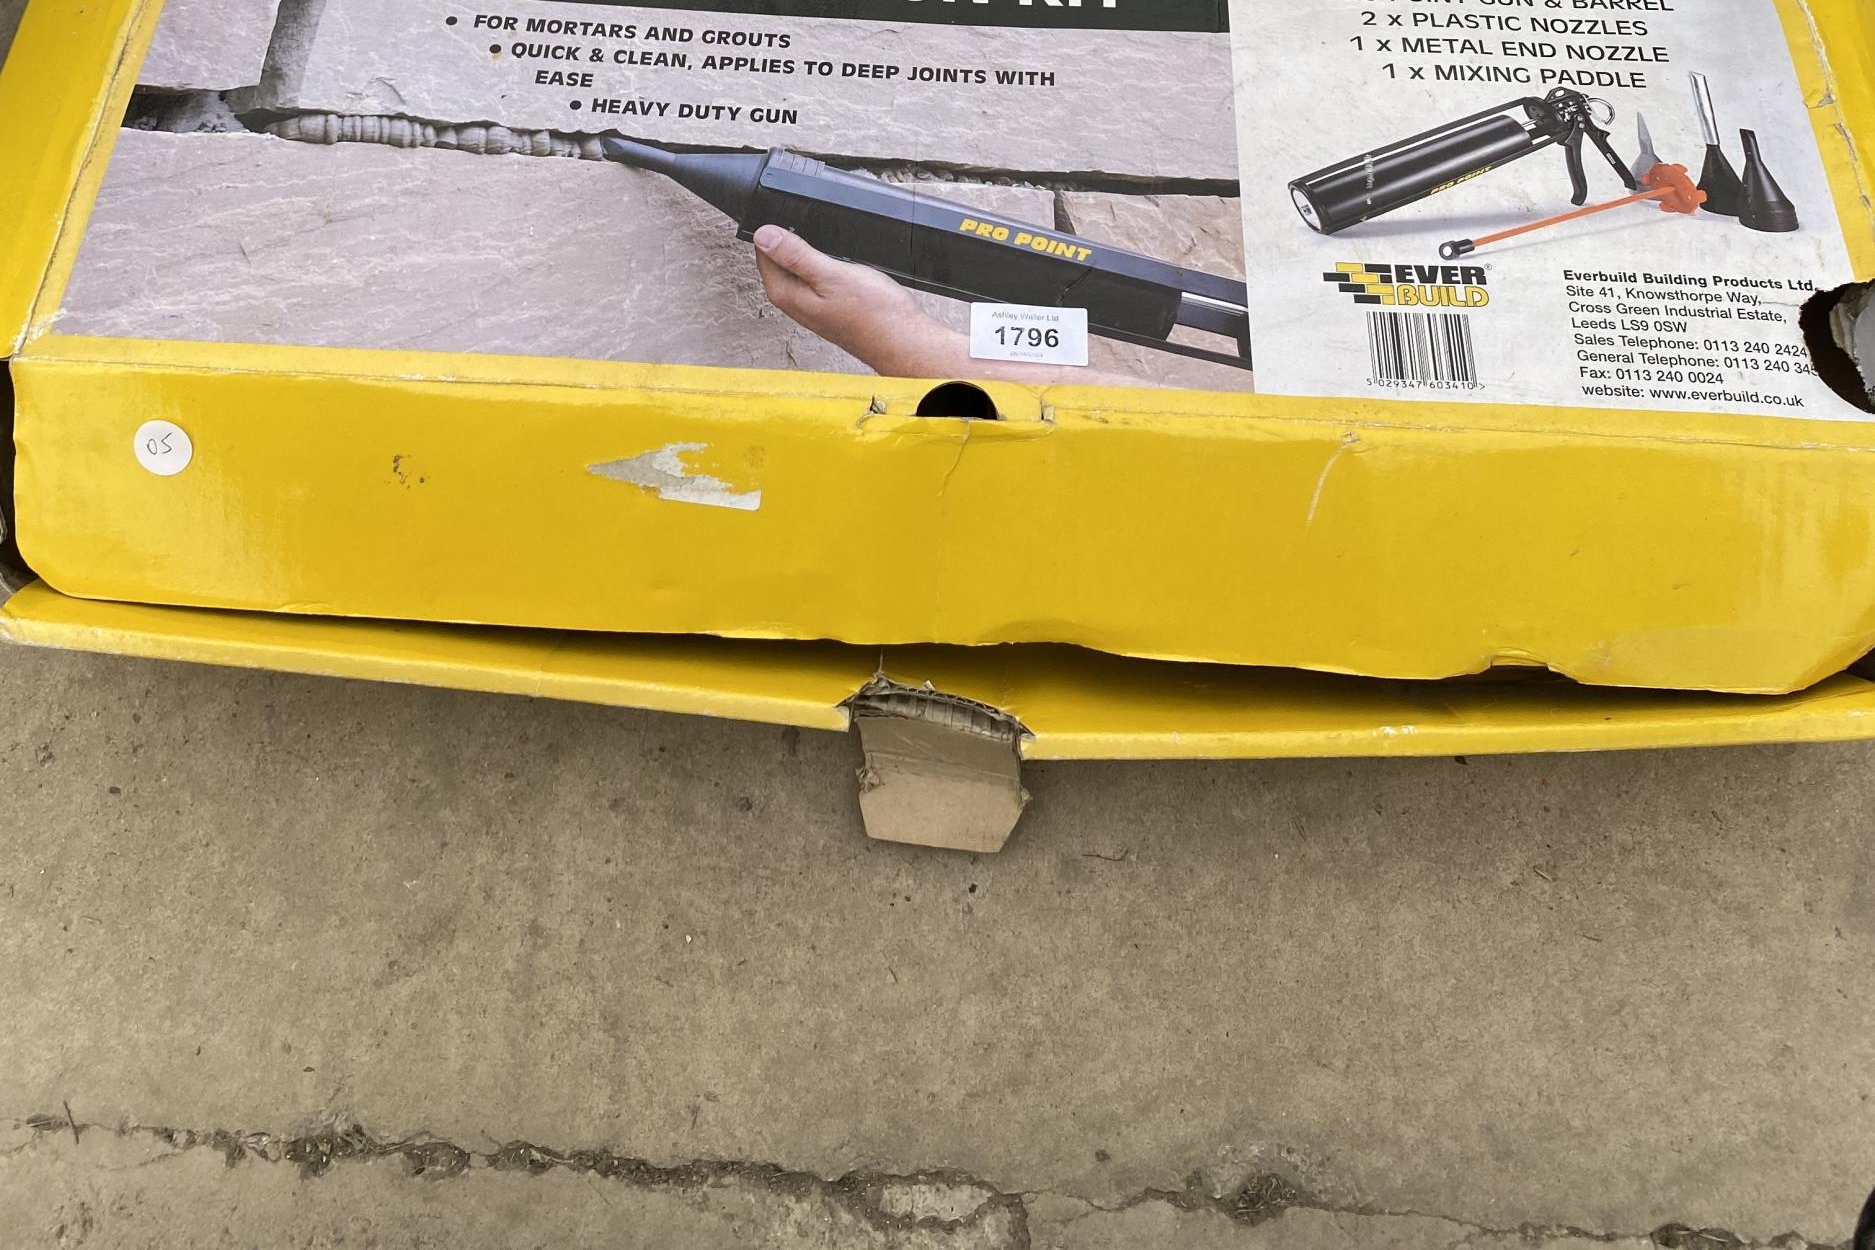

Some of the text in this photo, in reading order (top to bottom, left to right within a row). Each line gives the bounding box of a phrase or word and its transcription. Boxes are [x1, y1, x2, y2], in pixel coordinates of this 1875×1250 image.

[473, 14, 792, 49] FOR MORTARS AND GROUTS
[1362, 11, 1648, 36] 2 x PLASTIC NOZZLES
[1350, 35, 1670, 63] 1 x METAL END NOZZLE
[511, 42, 1056, 87] QUICK & CLEAN, APPLIES TO DEEP JOINTS WITH
[1382, 63, 1647, 88] 1 x MIXING PADDLE
[535, 70, 594, 88] EASE
[591, 97, 798, 125] HEAVY DUTY GUN
[959, 218, 1093, 261] PRO POINT
[1394, 264, 1487, 285] EVER
[1563, 270, 1638, 283] Everbuild
[1643, 273, 1708, 288] Building
[1712, 276, 1783, 290] Products
[1397, 284, 1489, 307] BUILD
[1565, 286, 1762, 306] Site 41, Knowsthorpe Way,
[1568, 302, 1787, 325] Cross Green Industrial Estate,
[1571, 317, 1617, 330] Leeds
[1621, 319, 1650, 332] LS9
[995, 326, 1059, 348] 1796
[1574, 334, 1808, 358] Sales Telephone: 0113 240 2424
[1577, 349, 1635, 364] General
[1638, 352, 1720, 370] Telephone:
[1723, 356, 1760, 370] 0113
[1764, 359, 1790, 373] 240
[1580, 366, 1724, 385] Fax: 0113 240 0024
[1582, 383, 1805, 408] website: www.everbuild.co.uk
